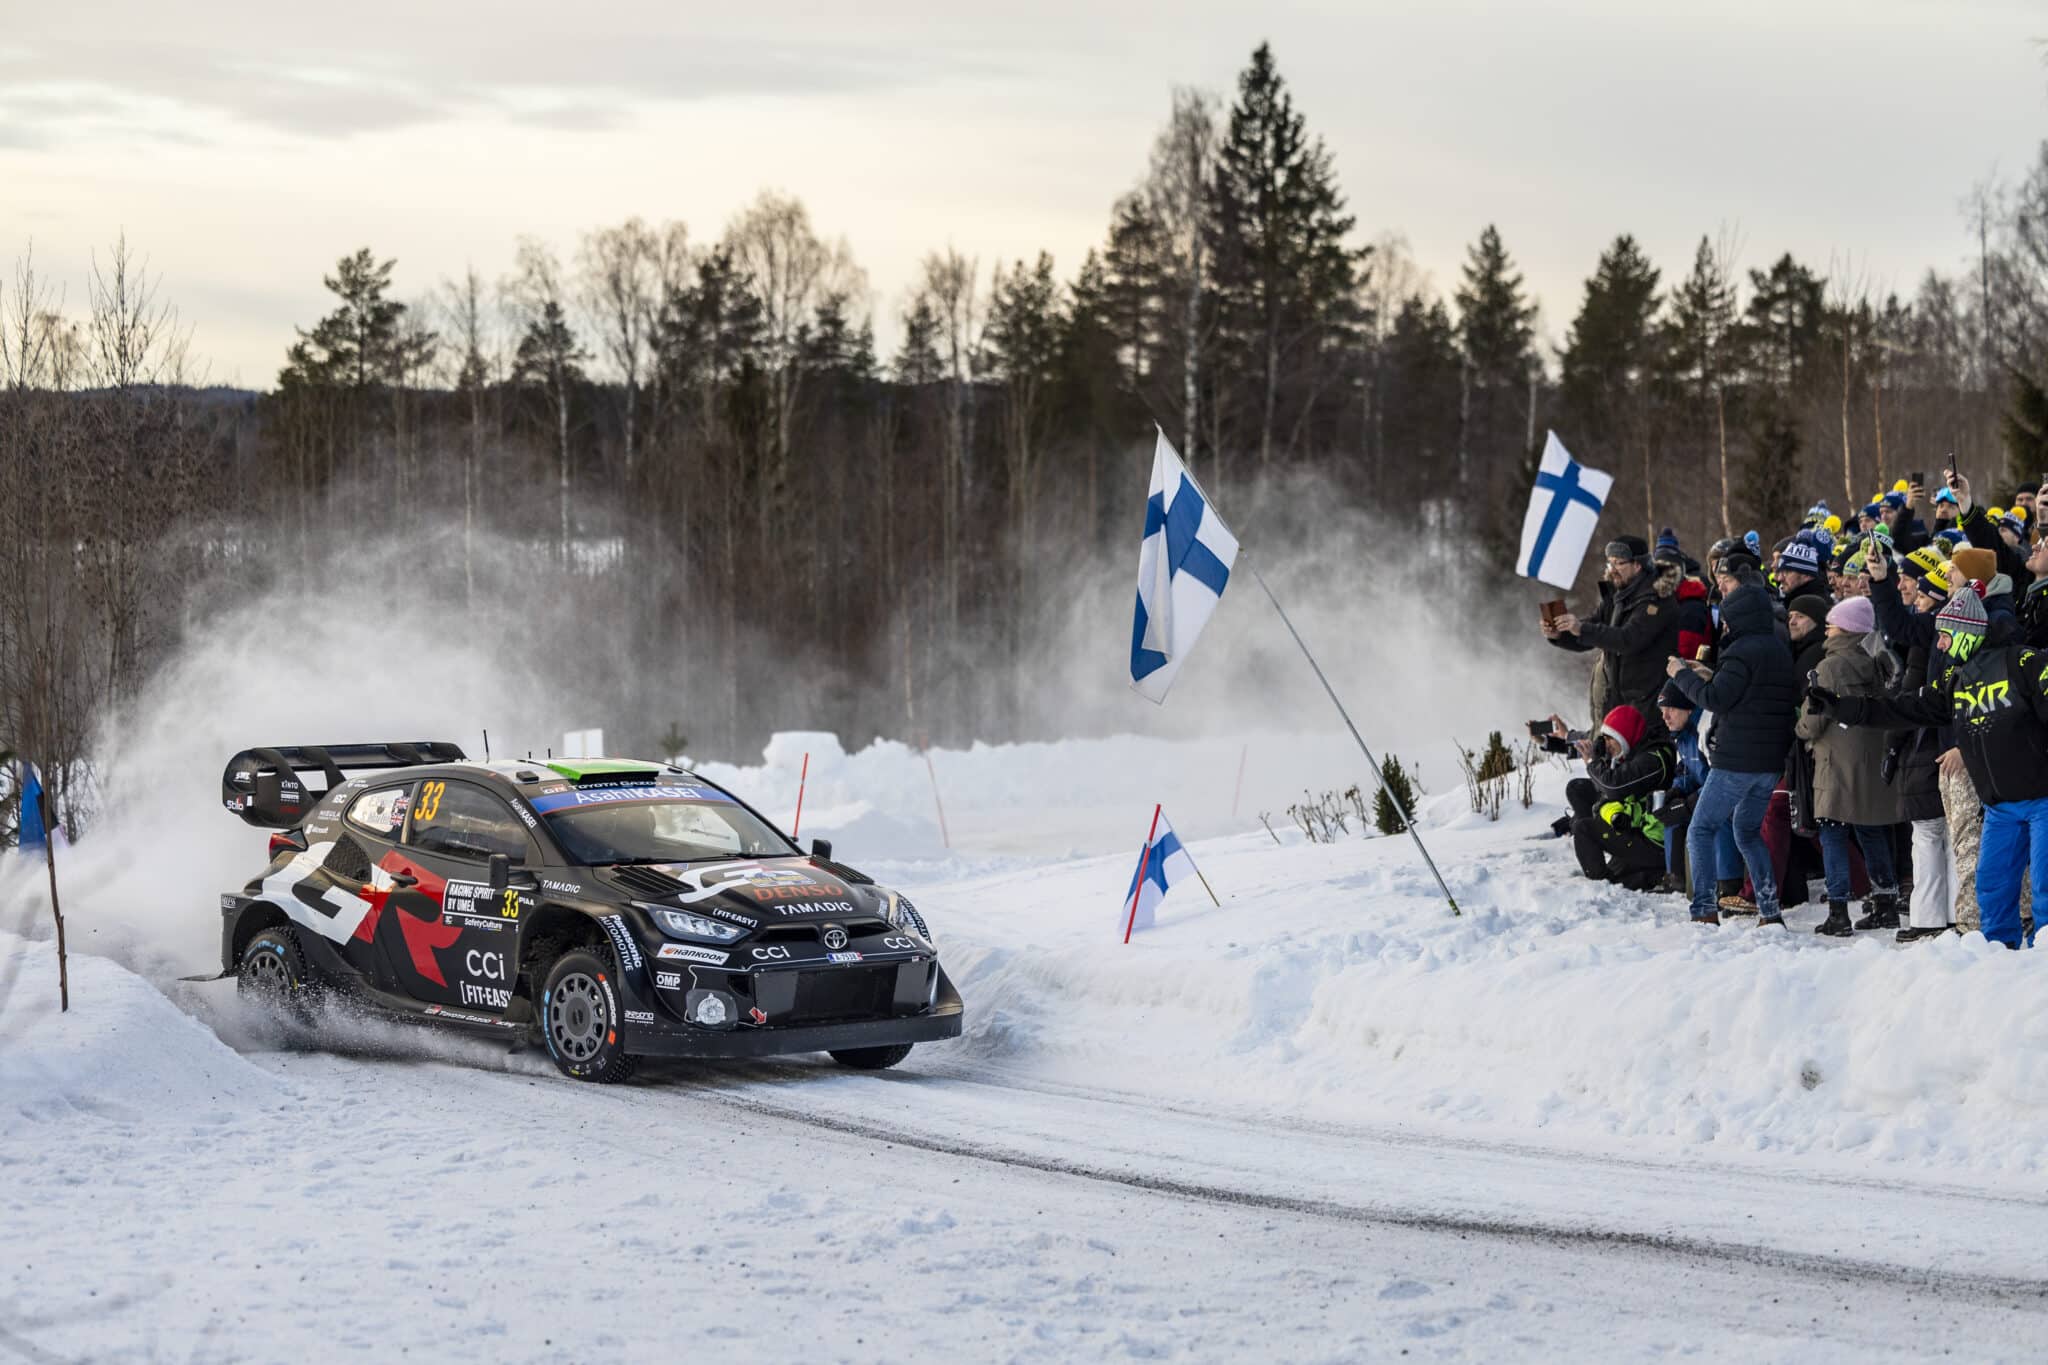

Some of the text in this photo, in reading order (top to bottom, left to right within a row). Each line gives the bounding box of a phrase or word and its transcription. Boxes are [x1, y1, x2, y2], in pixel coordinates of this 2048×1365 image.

[414, 781, 446, 821] 33
[574, 786, 702, 804] AsahiKASEI
[448, 883, 497, 901] RACING SPIRIT
[542, 880, 581, 894] TAMADIC
[754, 885, 844, 902] DENSO
[447, 898, 457, 911] BY
[501, 889, 519, 919] 33
[518, 896, 535, 906] PIAA
[774, 902, 854, 916] TAMADIC
[464, 918, 503, 930] SafetyCulture
[600, 916, 634, 972] AUTOMOTIVE
[609, 914, 643, 968] Panasonic
[656, 974, 681, 988] OMP
